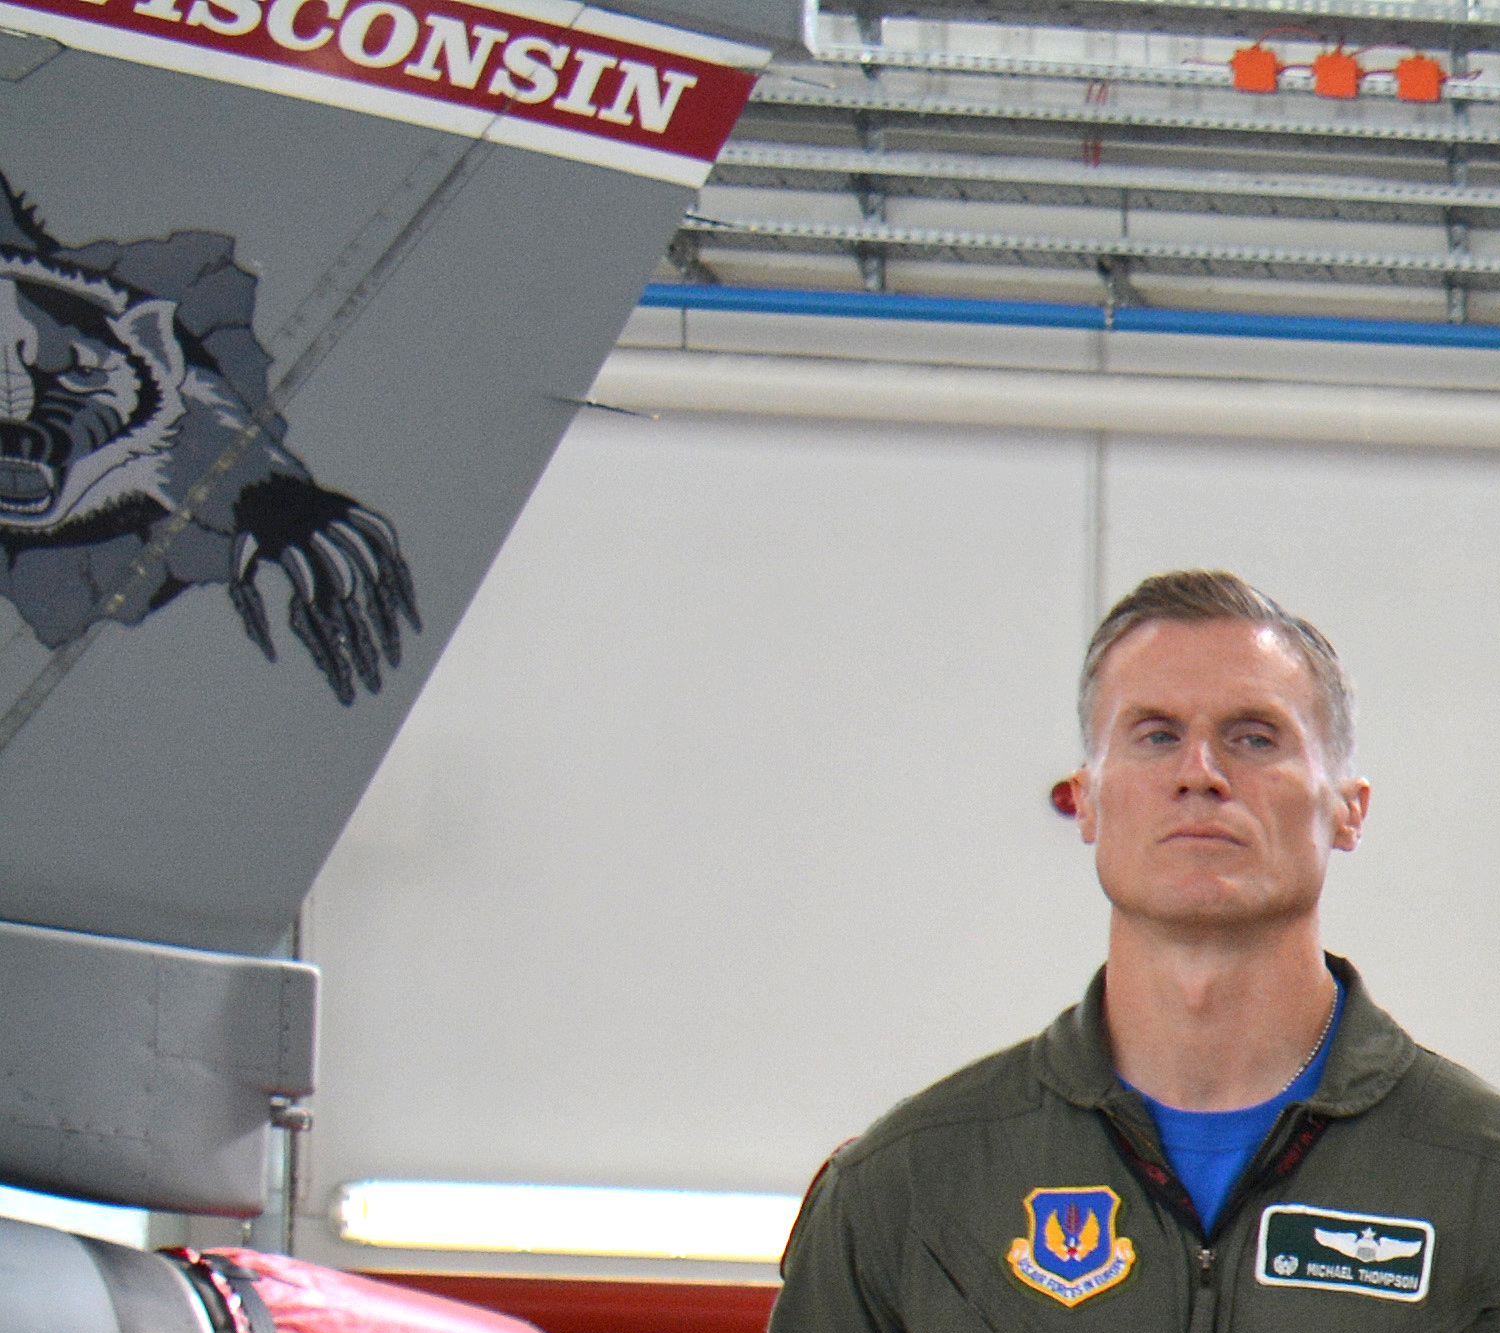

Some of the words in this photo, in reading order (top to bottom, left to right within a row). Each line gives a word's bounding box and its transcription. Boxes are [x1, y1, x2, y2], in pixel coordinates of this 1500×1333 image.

[75, 0, 698, 134] SCONSIN
[1306, 1261, 1354, 1281] MICHAEL
[1358, 1267, 1420, 1290] THOMPSON
